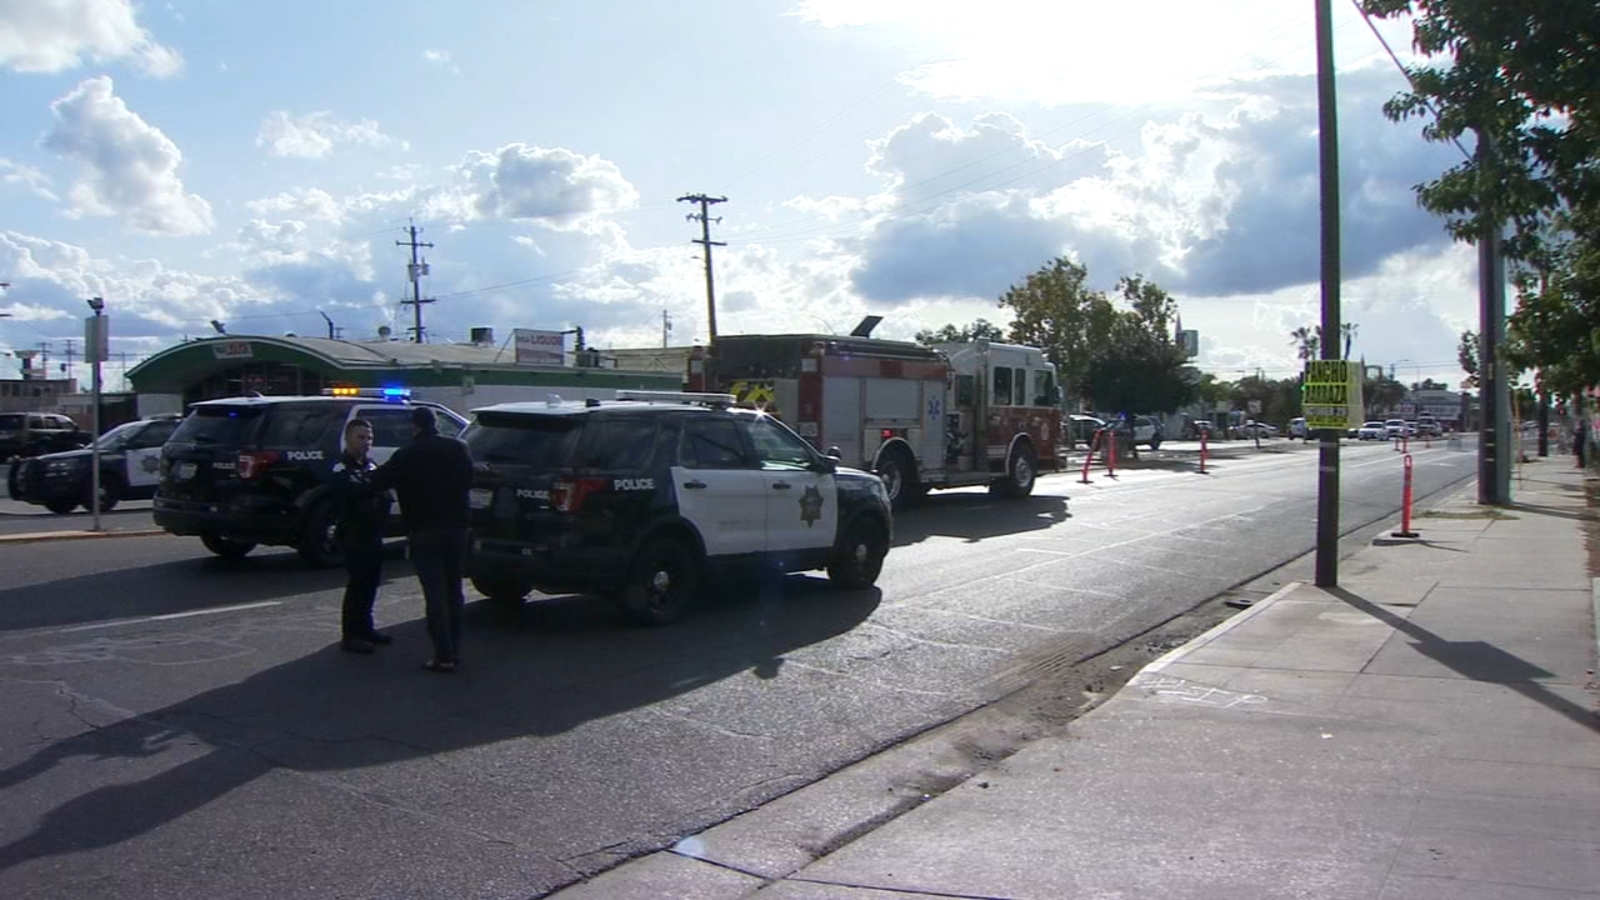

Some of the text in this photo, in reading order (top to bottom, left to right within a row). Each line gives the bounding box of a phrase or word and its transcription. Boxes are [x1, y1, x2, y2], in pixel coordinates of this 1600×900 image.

[531, 334, 562, 346] LIQUOR
[1305, 360, 1347, 383] PANCHO
[288, 451, 324, 460] POLICE
[213, 462, 236, 470] POLICE
[614, 478, 654, 490] POLICE
[516, 488, 549, 500] POLICE
